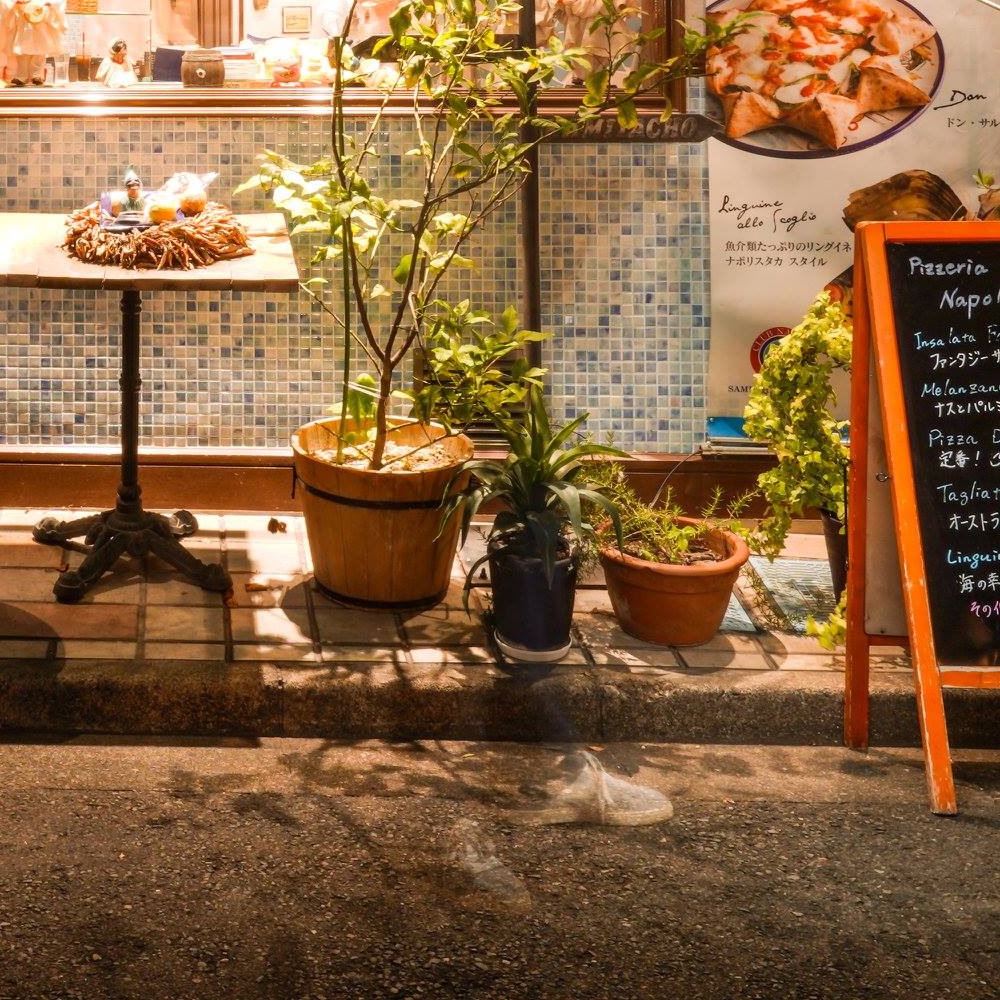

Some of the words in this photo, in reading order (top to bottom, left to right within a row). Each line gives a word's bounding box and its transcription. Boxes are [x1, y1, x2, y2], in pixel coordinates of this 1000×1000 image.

[719, 194, 784, 220] Linguine
[725, 240, 852, 252] 魚介類たっぷりのリングイネ
[790, 256, 829, 267] スタイル
[909, 256, 988, 275] Pizzeria
[914, 327, 977, 350] Insalata
[921, 379, 1000, 397] Melanzan
[929, 429, 978, 447] Pizza
[947, 549, 1000, 569] Lingui
